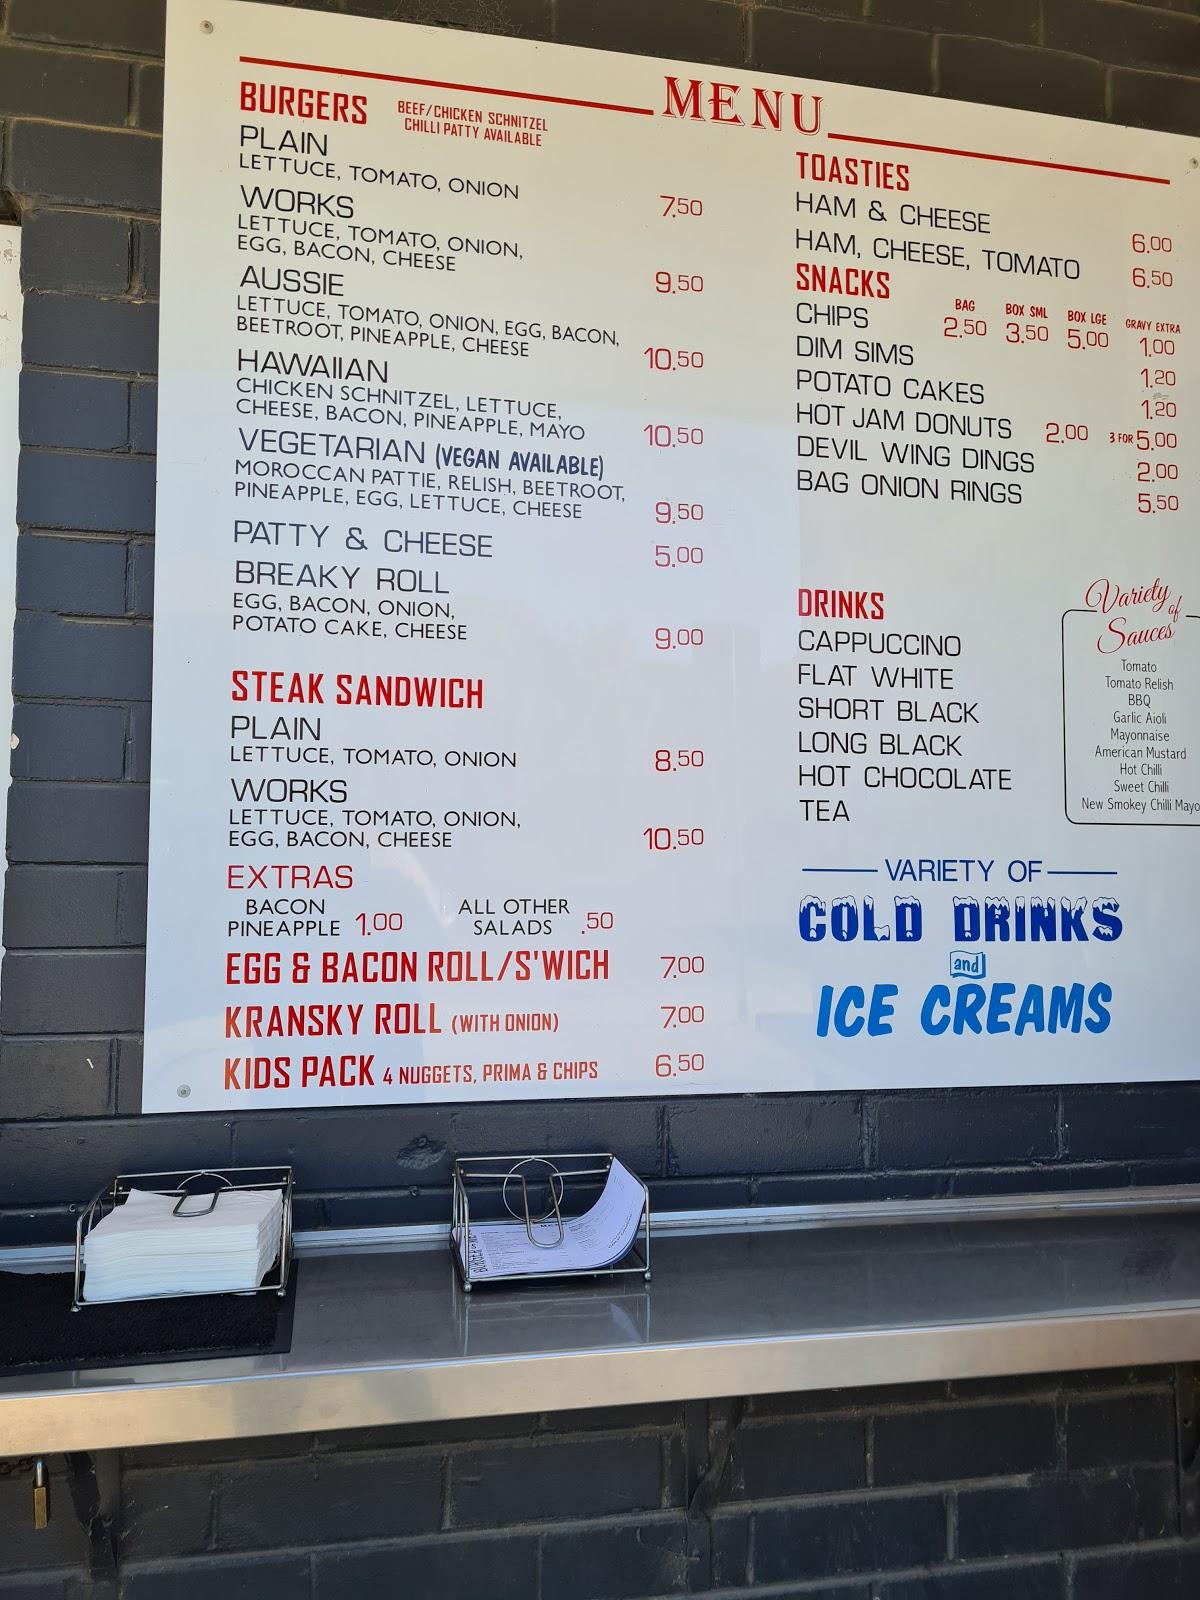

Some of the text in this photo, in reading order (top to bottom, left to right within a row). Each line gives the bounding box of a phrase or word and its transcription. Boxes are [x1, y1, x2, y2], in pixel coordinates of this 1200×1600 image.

[240, 81, 368, 125] BURGERS
[661, 76, 824, 136] MENU
[404, 117, 542, 147] CHILLI PATTY AVAILABLE
[488, 112, 548, 132] SCHNITZEL
[240, 124, 328, 157] PLAIN
[796, 151, 909, 192] TOASTIES
[240, 184, 354, 219] WORKS
[660, 195, 703, 218] 7.50
[796, 191, 991, 234] HAM & CHEESE
[796, 228, 1080, 280] HAM, CHEESE, TOMATO
[1132, 233, 1172, 254] 6.00
[239, 265, 344, 297] AUSSIE
[655, 271, 703, 294] 9.50
[796, 262, 890, 299] SNACKS
[1132, 267, 1173, 289] 6.50
[796, 302, 869, 329] CHIPS
[955, 298, 976, 312] BAG
[1005, 303, 1049, 319] BOX SML
[237, 294, 619, 348] LETTUCE, TOMATO, ONION, EGG, BACON,
[944, 316, 987, 339] 2.50
[1067, 310, 1107, 326] BOX LGE
[1125, 318, 1181, 334] GRAVY EXTRA
[1006, 322, 1049, 344] 3.50
[1067, 328, 1109, 350] 5.00
[644, 347, 704, 371] 10.50
[796, 335, 914, 366] DIM SIMS
[1139, 337, 1175, 358] 1.00
[238, 348, 388, 384] HAWAIIAN
[1140, 368, 1176, 389] 1.20
[236, 377, 562, 421] CHICKEN SCHNITZEL, LETTUCE,
[1141, 398, 1177, 420] 1.20
[796, 402, 1012, 440] HOT JAM DONUTS
[1046, 422, 1089, 444] 2.00
[238, 427, 425, 464] VEGETARIAN
[643, 424, 704, 448] 10.50
[1109, 430, 1177, 452] 3 FOR 5.00
[235, 459, 625, 502] MOROCCAN PATTIE, RELISH, BEETROOT,
[1137, 461, 1178, 483] 2.00
[797, 469, 1022, 505] BAG ONION RINGS
[655, 498, 704, 524] 9.50
[1138, 492, 1179, 514] 5.50
[234, 520, 493, 558] PATTY & CHEESE
[655, 545, 703, 568] 5.00
[235, 560, 450, 594] BREAKY ROLL
[233, 592, 455, 621] EGG, BACON, ONION,
[798, 588, 884, 620] DRINKS
[1085, 577, 1183, 623] Variety of
[655, 627, 703, 650] 9.00
[798, 629, 961, 657] CAPPUCCINO
[1097, 617, 1175, 654] Sauces
[798, 663, 954, 690] FLAT WHITE
[1121, 659, 1157, 673] Tomato
[231, 670, 483, 709] STEAK SANDWICH
[1105, 675, 1174, 691] Tomato Relish
[798, 696, 980, 724] SHORT BLACK
[1128, 693, 1151, 709] BBQ
[231, 715, 321, 741] PLAIN
[1113, 710, 1167, 725] Garlic Aioli
[1111, 728, 1170, 745] Mayonnaise
[230, 745, 516, 768] LETTUCE, TOMATO, ONION
[655, 749, 704, 772] 8.50
[1095, 745, 1187, 760] American Mustard
[799, 764, 1012, 790] HOT CHOCOLATE
[1120, 762, 1162, 776] Hot Chilli
[230, 778, 347, 803] WORKS
[1113, 779, 1169, 793] Sweet Chilli
[799, 799, 850, 822] TEA
[1082, 797, 1103, 810] New
[1107, 797, 1147, 814] Smokey
[1150, 798, 1172, 811] Chilli
[642, 827, 704, 850] 10.50
[228, 864, 353, 889] EXTRAS
[884, 858, 1043, 883] VARIETY OF
[246, 898, 325, 915] BACON
[458, 898, 570, 915] ALL OTHER
[798, 894, 1123, 942] COLD DRINKS
[228, 920, 341, 937] PINEAPPLE
[355, 912, 403, 936] 1.00
[473, 919, 552, 936] SALADS
[226, 952, 281, 985] EGG
[290, 952, 311, 985] &
[321, 951, 417, 984] BACON
[660, 956, 705, 979] 7.00
[953, 956, 980, 975] and
[225, 1004, 364, 1041] KRANSKY
[375, 1002, 442, 1035] ROLL
[660, 1005, 704, 1029] 7.00
[816, 981, 1113, 1038] ICE CREAMS
[224, 1054, 598, 1090] KIDS PACK 4 NUGGETS, PRIMA & CHIPS
[655, 1053, 704, 1078] 6.50
